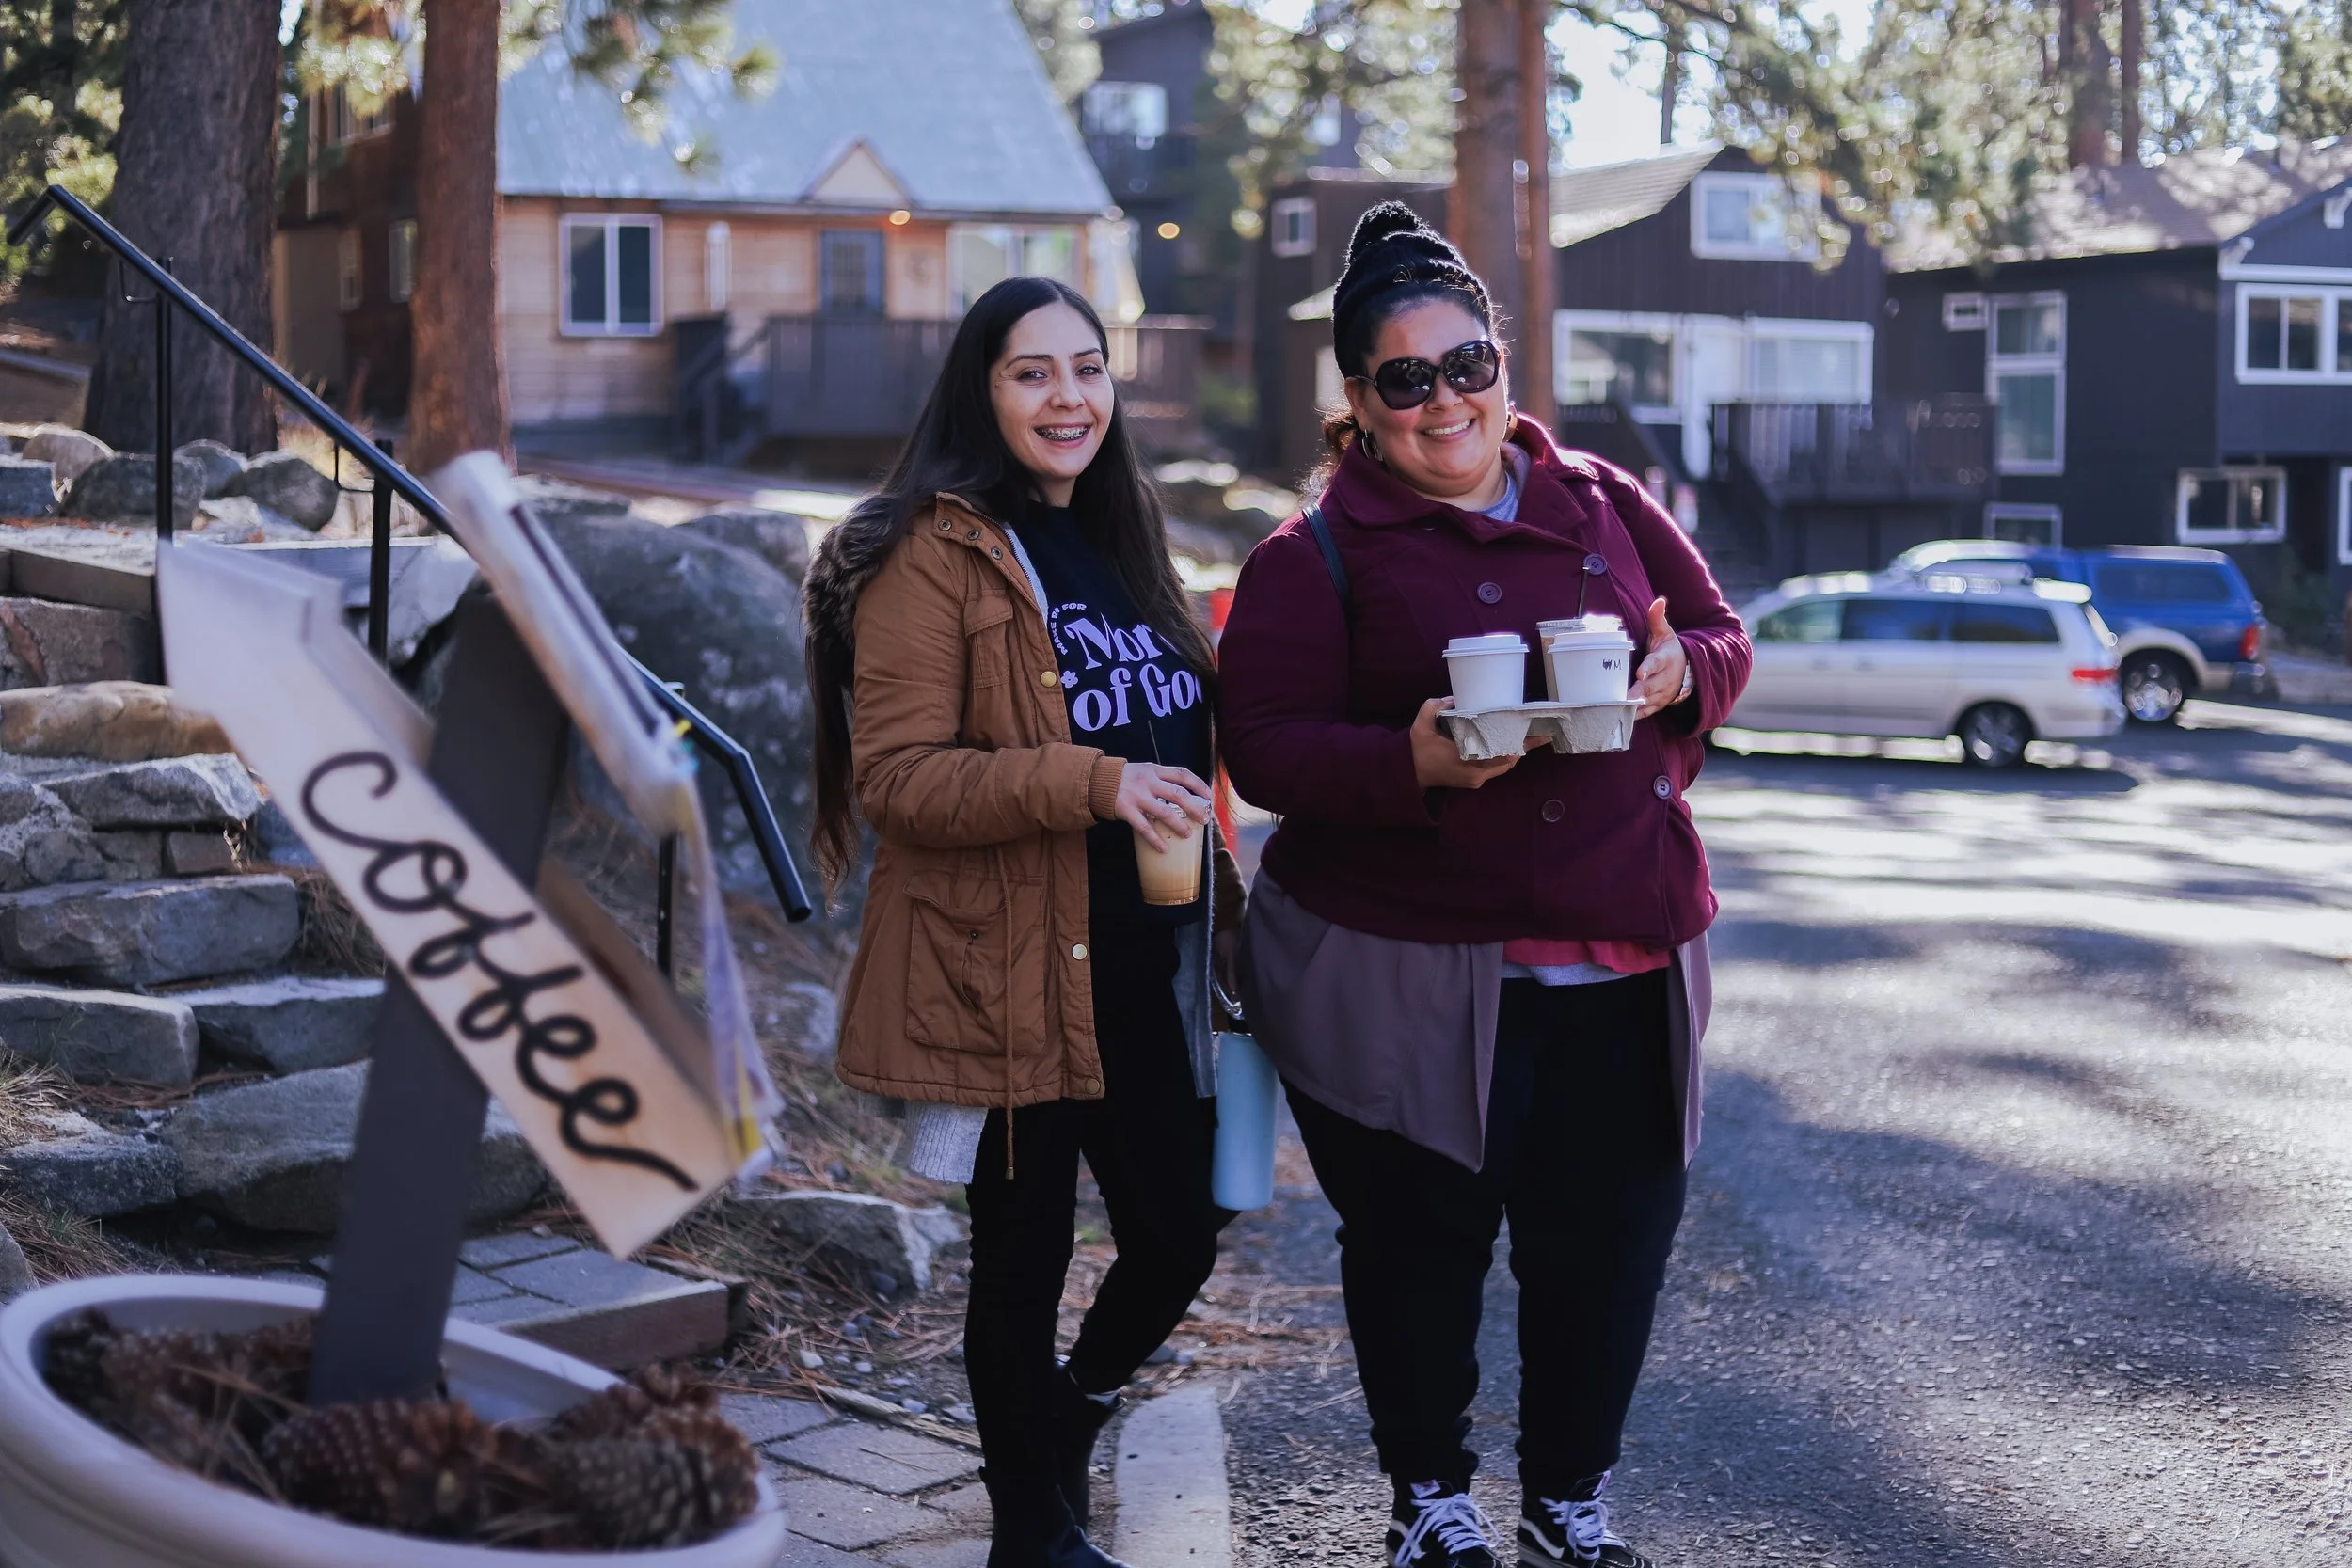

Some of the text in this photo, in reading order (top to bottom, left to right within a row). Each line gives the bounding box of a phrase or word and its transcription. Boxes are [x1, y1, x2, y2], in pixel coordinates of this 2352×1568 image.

[1050, 622, 1068, 656] MAKE
[1061, 602, 1087, 611] FOR
[1064, 612, 1180, 670] Mor
[1073, 667, 1133, 732] of
[300, 752, 701, 1193] Coffee
